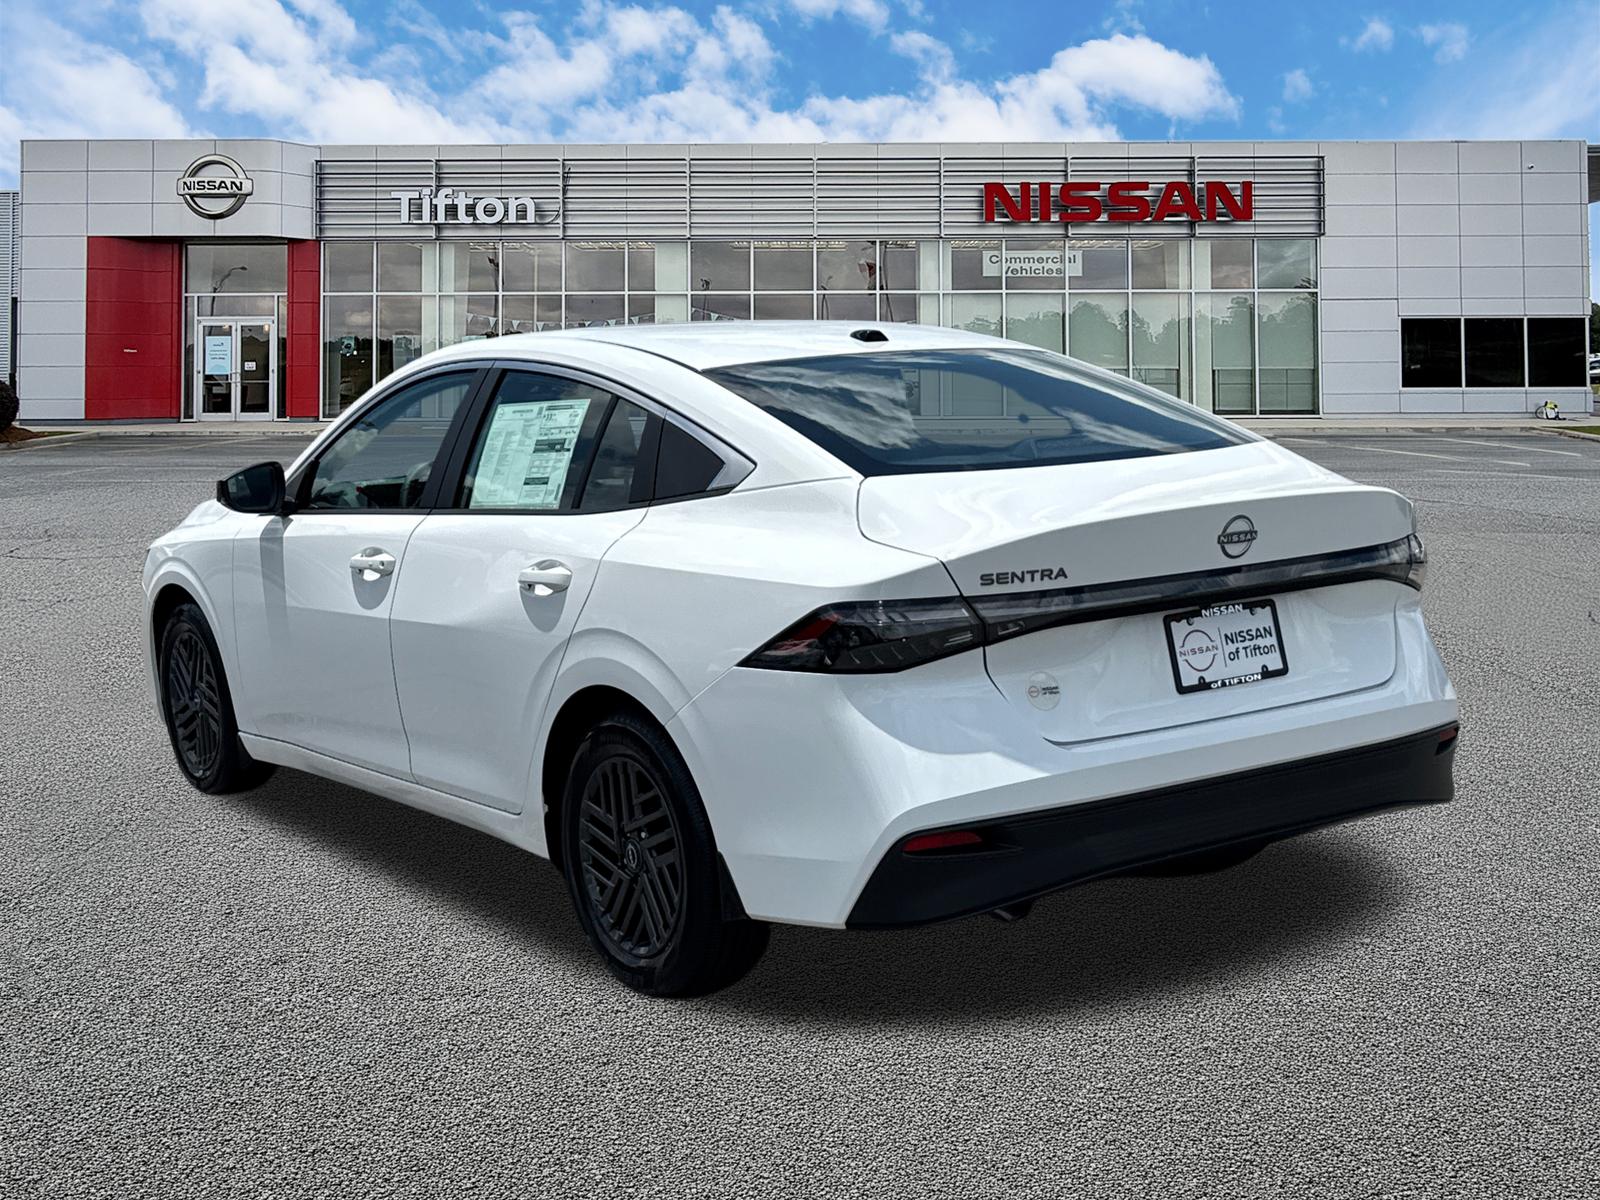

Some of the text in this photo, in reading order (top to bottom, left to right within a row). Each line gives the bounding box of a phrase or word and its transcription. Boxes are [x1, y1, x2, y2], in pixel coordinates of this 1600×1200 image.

[181, 180, 244, 193] NISSAN
[390, 188, 537, 224] Tifton
[983, 181, 1254, 223] NISSAN
[1220, 532, 1257, 543] NISSAN
[979, 567, 1068, 586] SENTRA
[1201, 604, 1243, 618] NISSAN
[1224, 626, 1273, 645] NISSAN
[1179, 645, 1219, 658] NISSAN
[1228, 644, 1277, 661] of Tifton
[1211, 674, 1262, 689] of TIFTON
